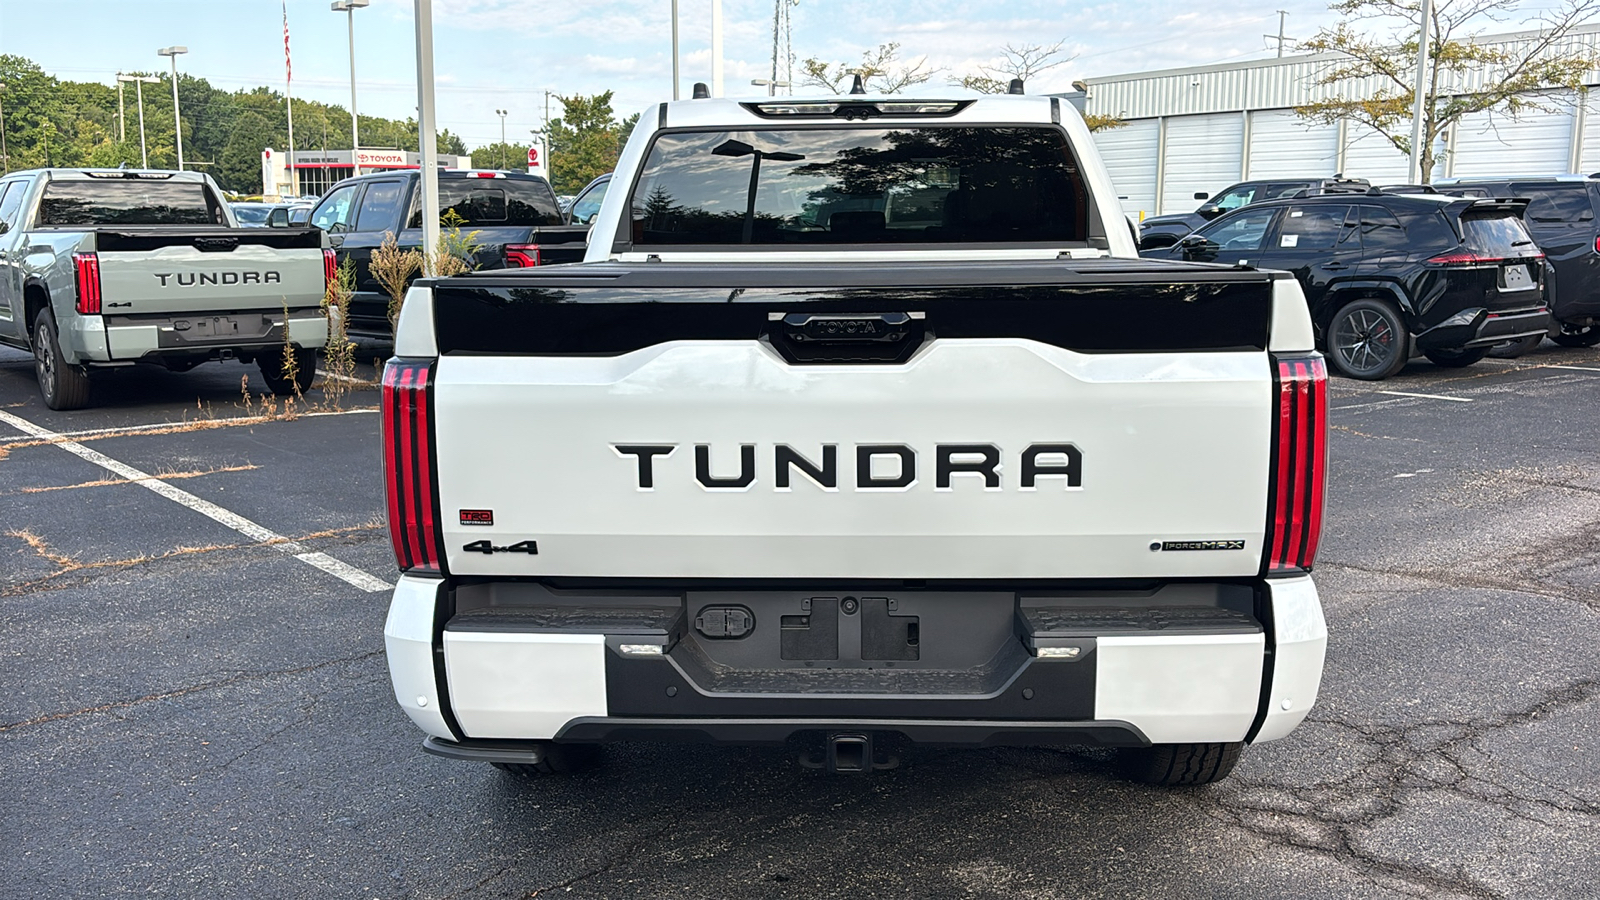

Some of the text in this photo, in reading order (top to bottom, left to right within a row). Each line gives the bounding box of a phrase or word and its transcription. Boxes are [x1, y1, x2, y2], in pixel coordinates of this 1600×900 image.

[370, 155, 403, 163] TOYOTA
[154, 271, 281, 287] TUNDRA
[817, 321, 877, 333] TOYOTA
[610, 443, 1084, 491] TUNDRA
[461, 511, 491, 520] TRD
